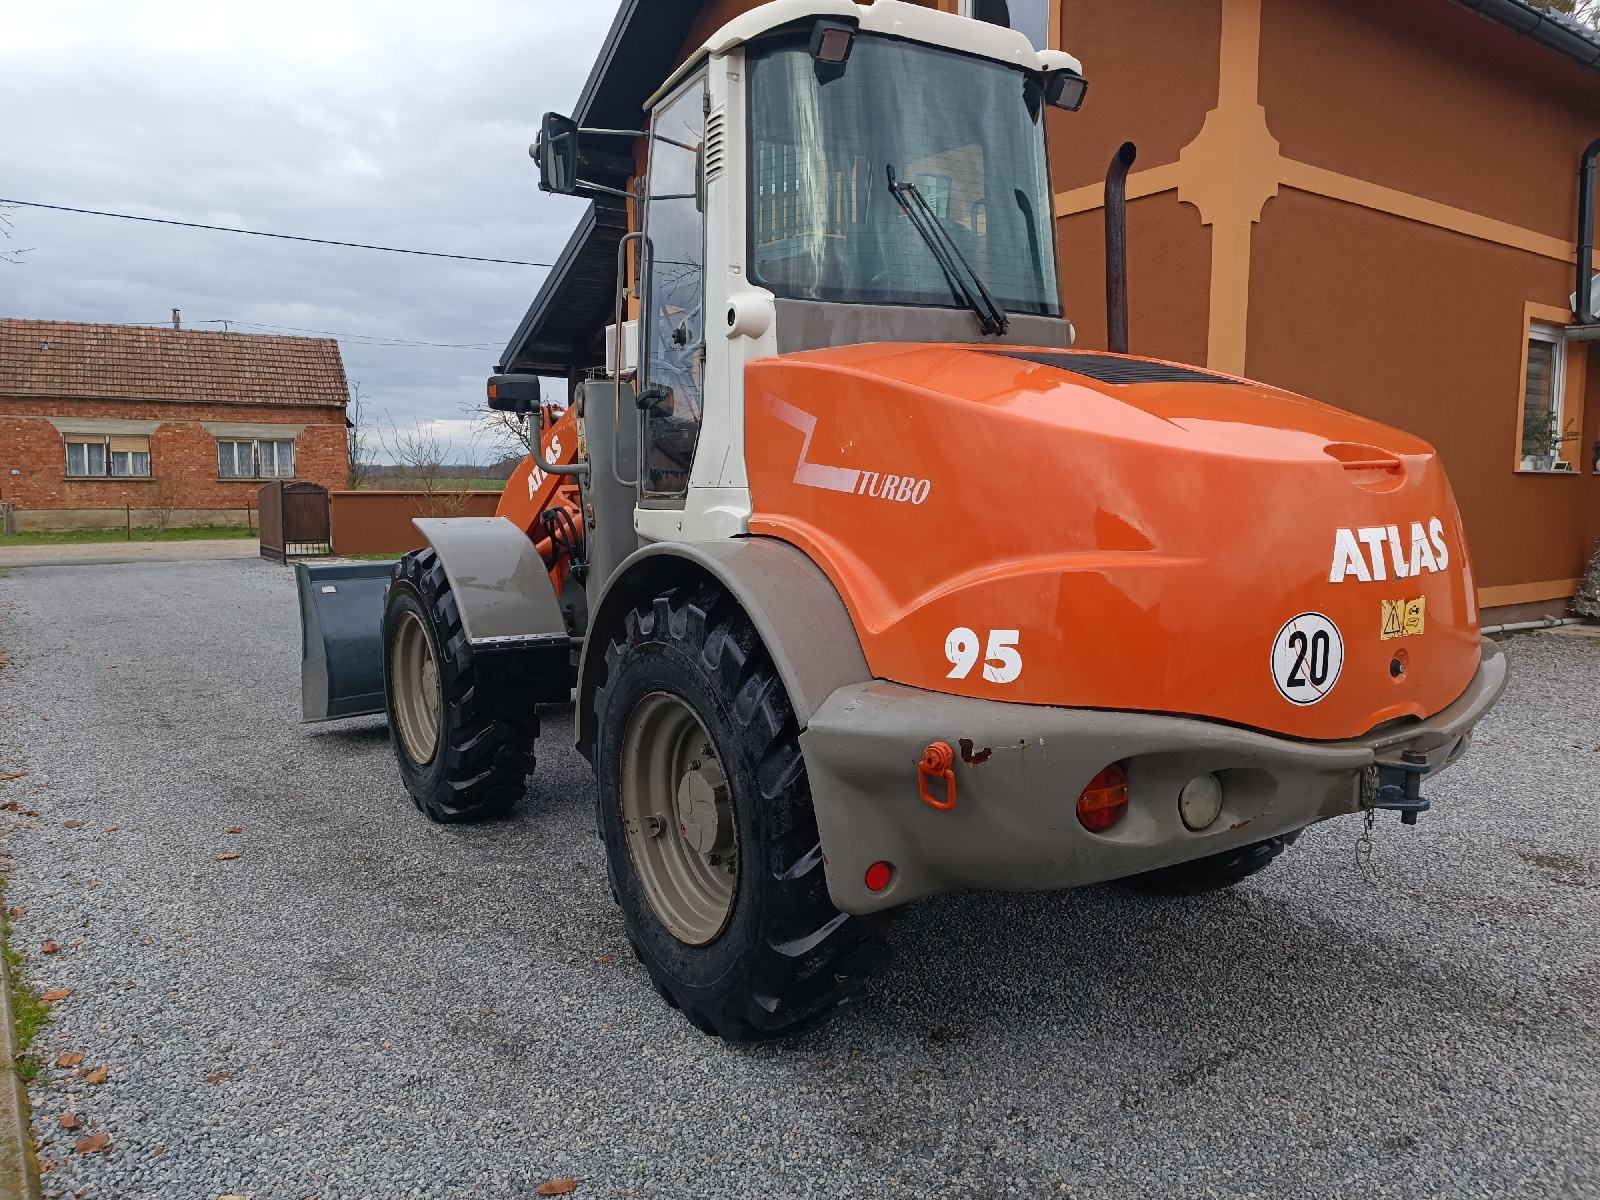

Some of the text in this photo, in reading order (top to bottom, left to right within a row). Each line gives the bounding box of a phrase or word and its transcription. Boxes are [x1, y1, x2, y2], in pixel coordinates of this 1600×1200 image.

[857, 470, 931, 505] TURBO
[1328, 516, 1449, 583] ATLAS
[944, 626, 1023, 684] 95
[1286, 629, 1330, 688] 20
